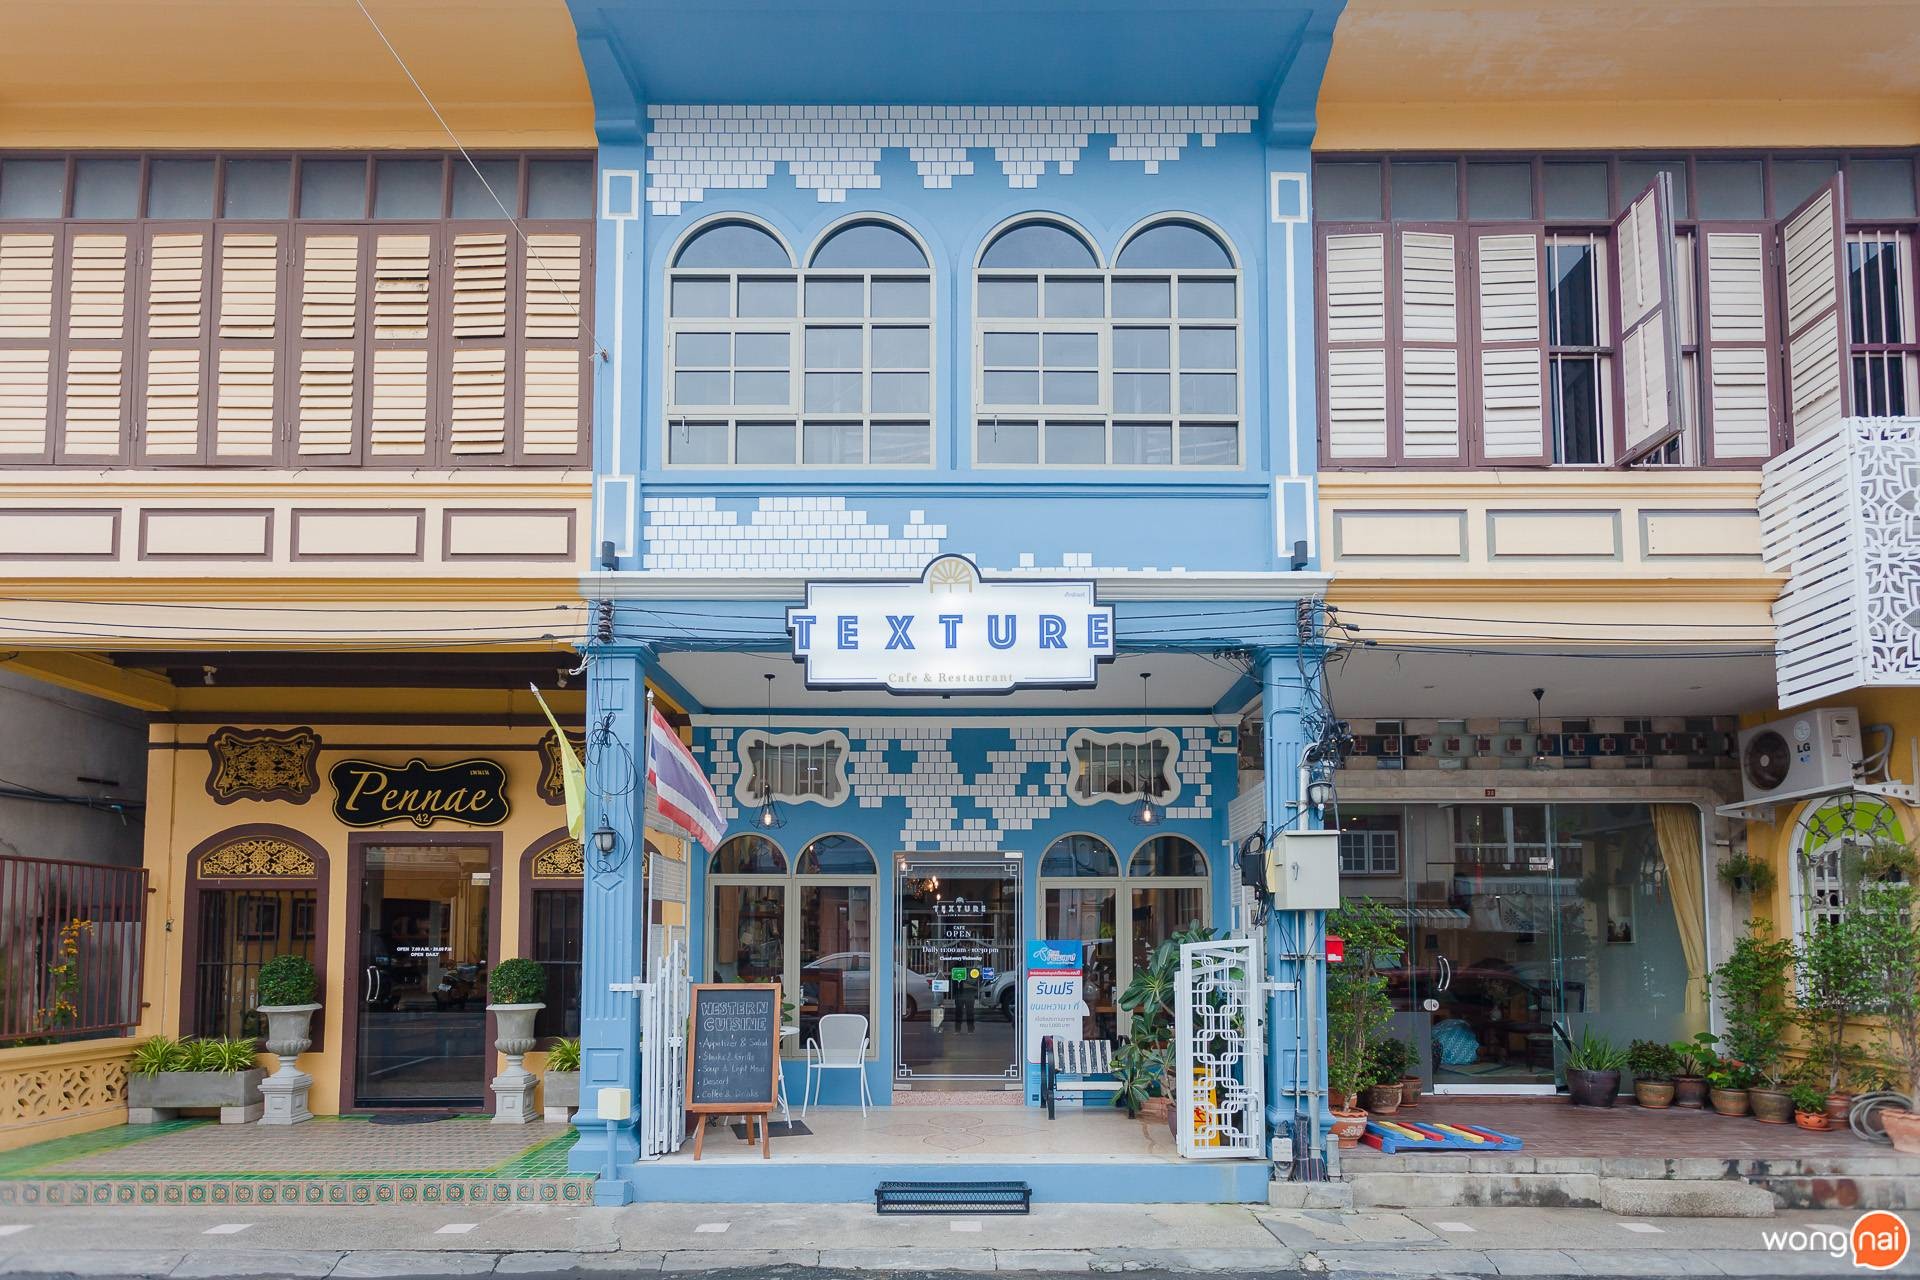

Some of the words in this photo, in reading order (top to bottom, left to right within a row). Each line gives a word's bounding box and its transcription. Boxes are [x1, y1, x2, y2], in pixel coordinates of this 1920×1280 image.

[792, 614, 1109, 650] TEXTURE
[888, 672, 918, 683] Cafe
[923, 672, 933, 683] &
[938, 672, 1014, 683] Restaurant
[1797, 742, 1811, 753] LG
[345, 770, 494, 812] Pennae
[415, 813, 429, 823] 42
[932, 905, 987, 913] TEXTURE
[946, 930, 972, 938] OPEN
[922, 945, 939, 954] Daily
[1036, 981, 1074, 995] รับฟรี
[700, 1001, 769, 1016] WESTERN
[703, 1017, 767, 1031] CUISINE
